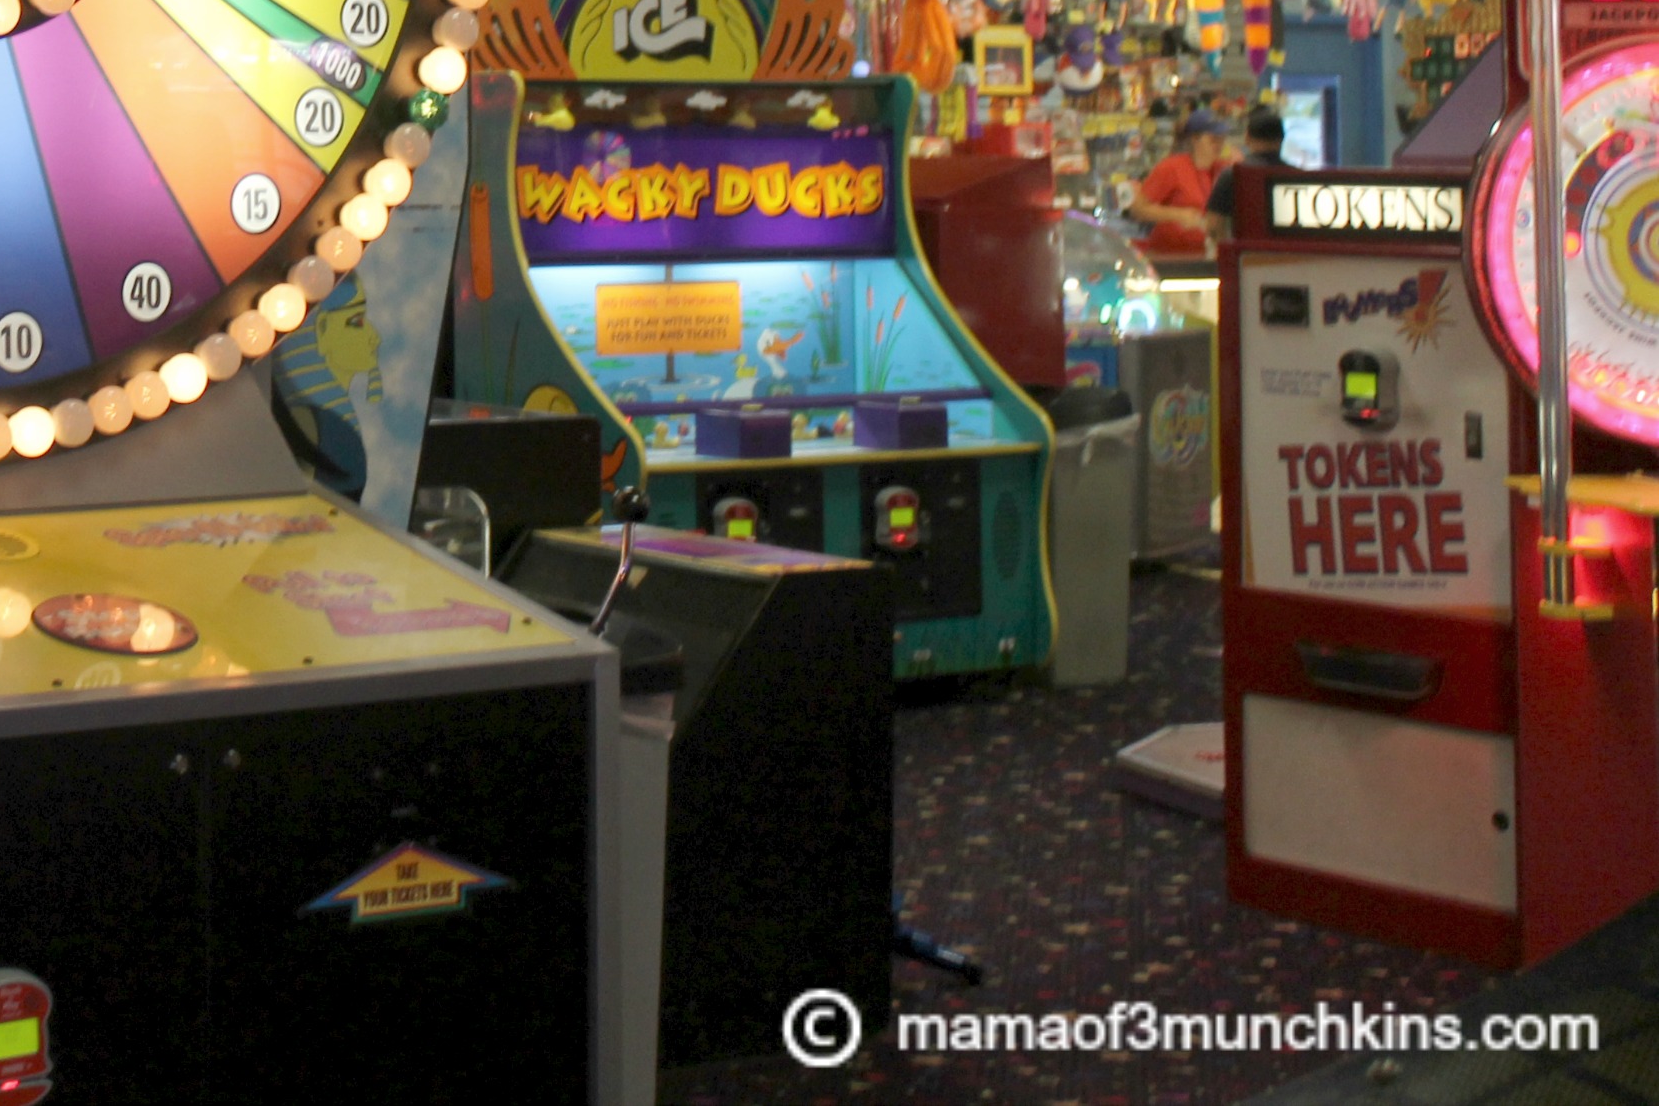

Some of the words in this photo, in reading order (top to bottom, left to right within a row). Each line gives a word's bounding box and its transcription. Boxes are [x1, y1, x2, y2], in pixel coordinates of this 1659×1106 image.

[349, 2, 381, 35] 20
[315, 41, 363, 90] 1000
[305, 101, 335, 133] 20
[242, 187, 269, 221] 15
[516, 162, 710, 224] WACKY
[714, 160, 884, 218] DUCKS
[1281, 184, 1456, 232] TOKENS
[129, 275, 162, 310] 40
[0, 324, 33, 360] 10
[1279, 439, 1444, 491] TOKENS
[1288, 491, 1469, 576] HERE
